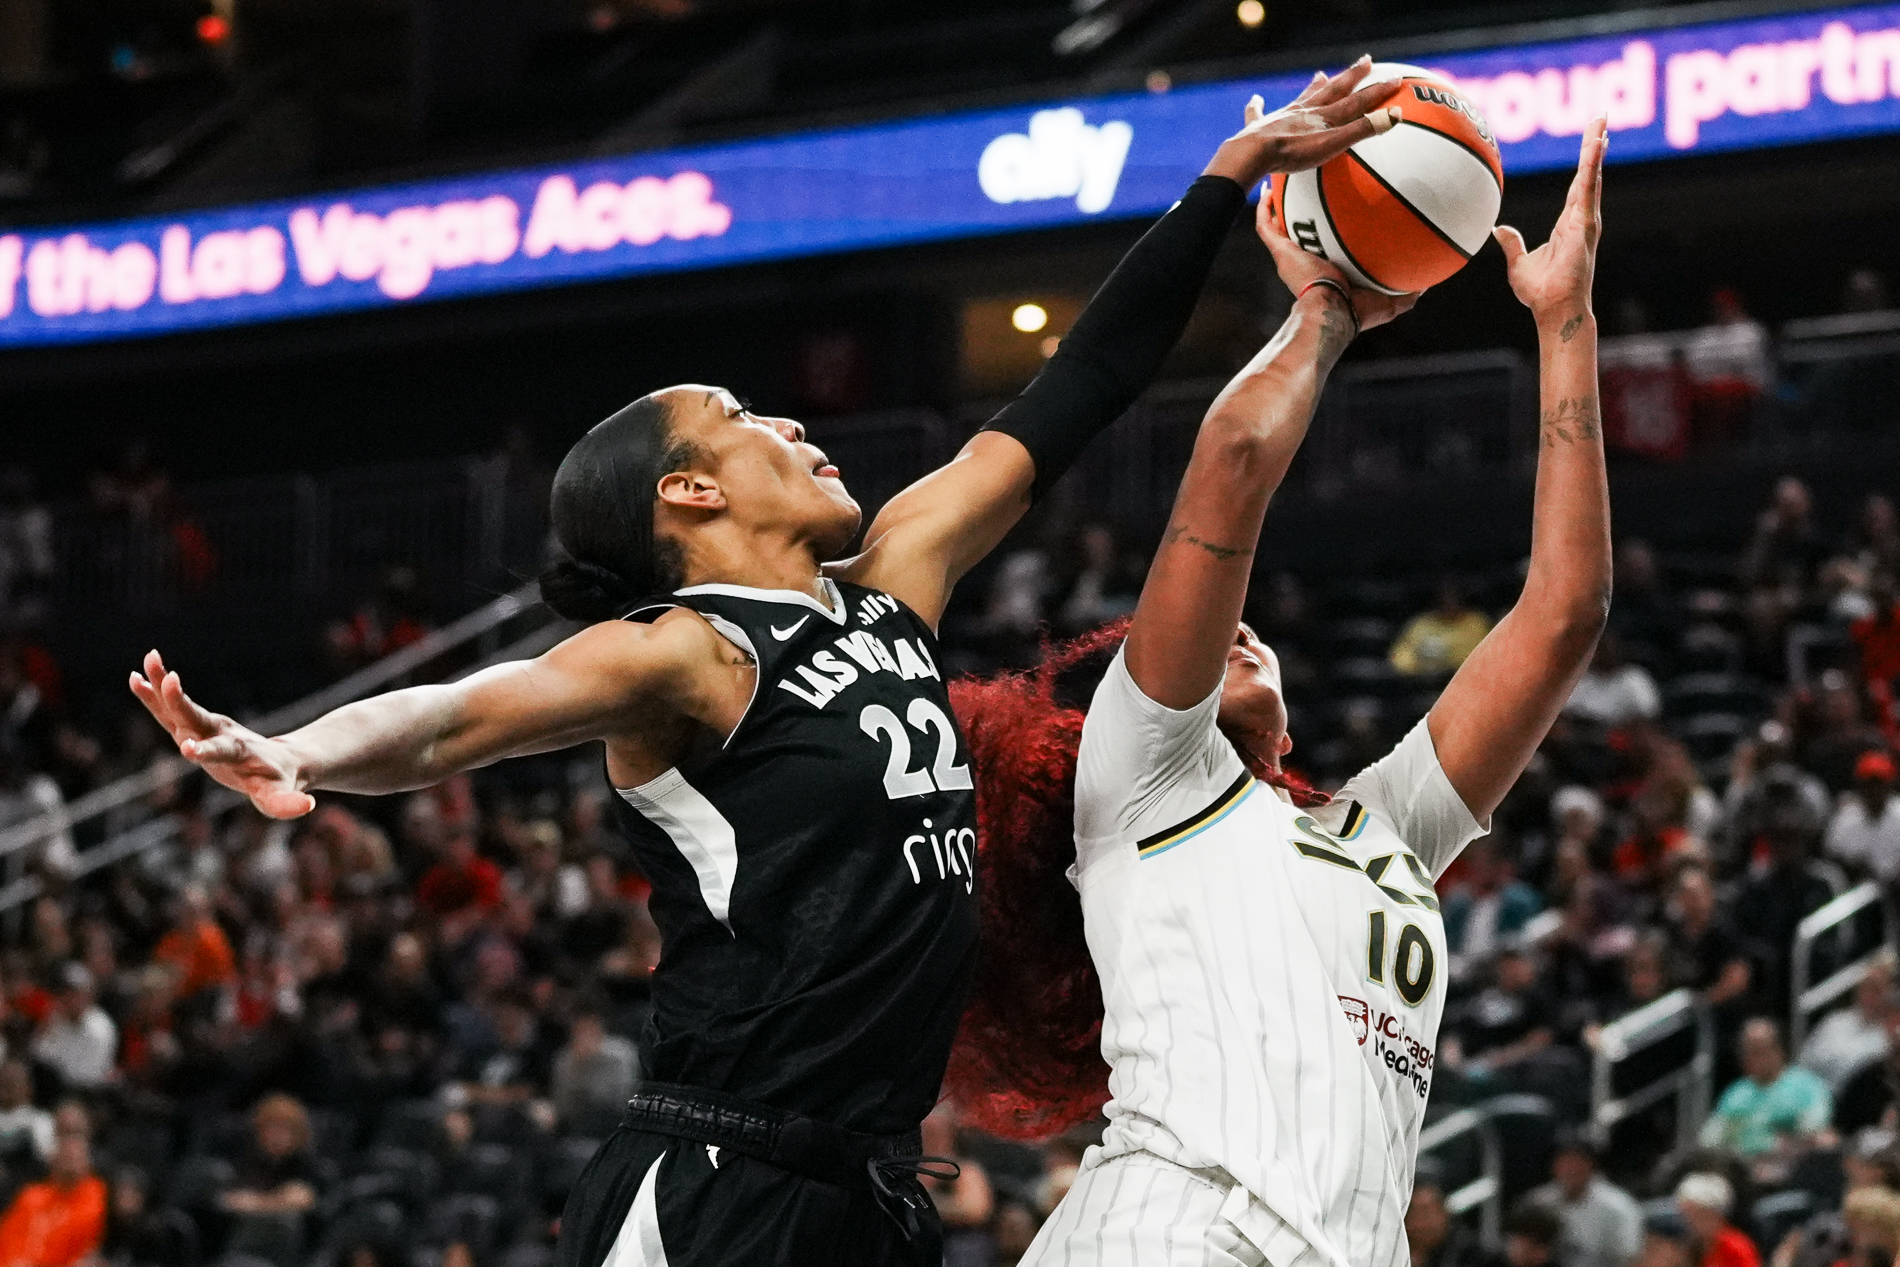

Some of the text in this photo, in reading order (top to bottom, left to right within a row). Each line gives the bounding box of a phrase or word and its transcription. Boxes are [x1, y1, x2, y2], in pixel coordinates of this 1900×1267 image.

[1428, 41, 1655, 142] roud
[979, 108, 1133, 213] ally
[27, 233, 157, 316] the
[161, 225, 286, 303] Las
[290, 196, 519, 299] Vegas
[524, 172, 731, 258] Aces.
[777, 650, 859, 710] LAS
[860, 698, 974, 799] 22
[903, 818, 976, 894] ring
[1367, 907, 1436, 1008] 10
[1375, 1034, 1428, 1099] Medine
